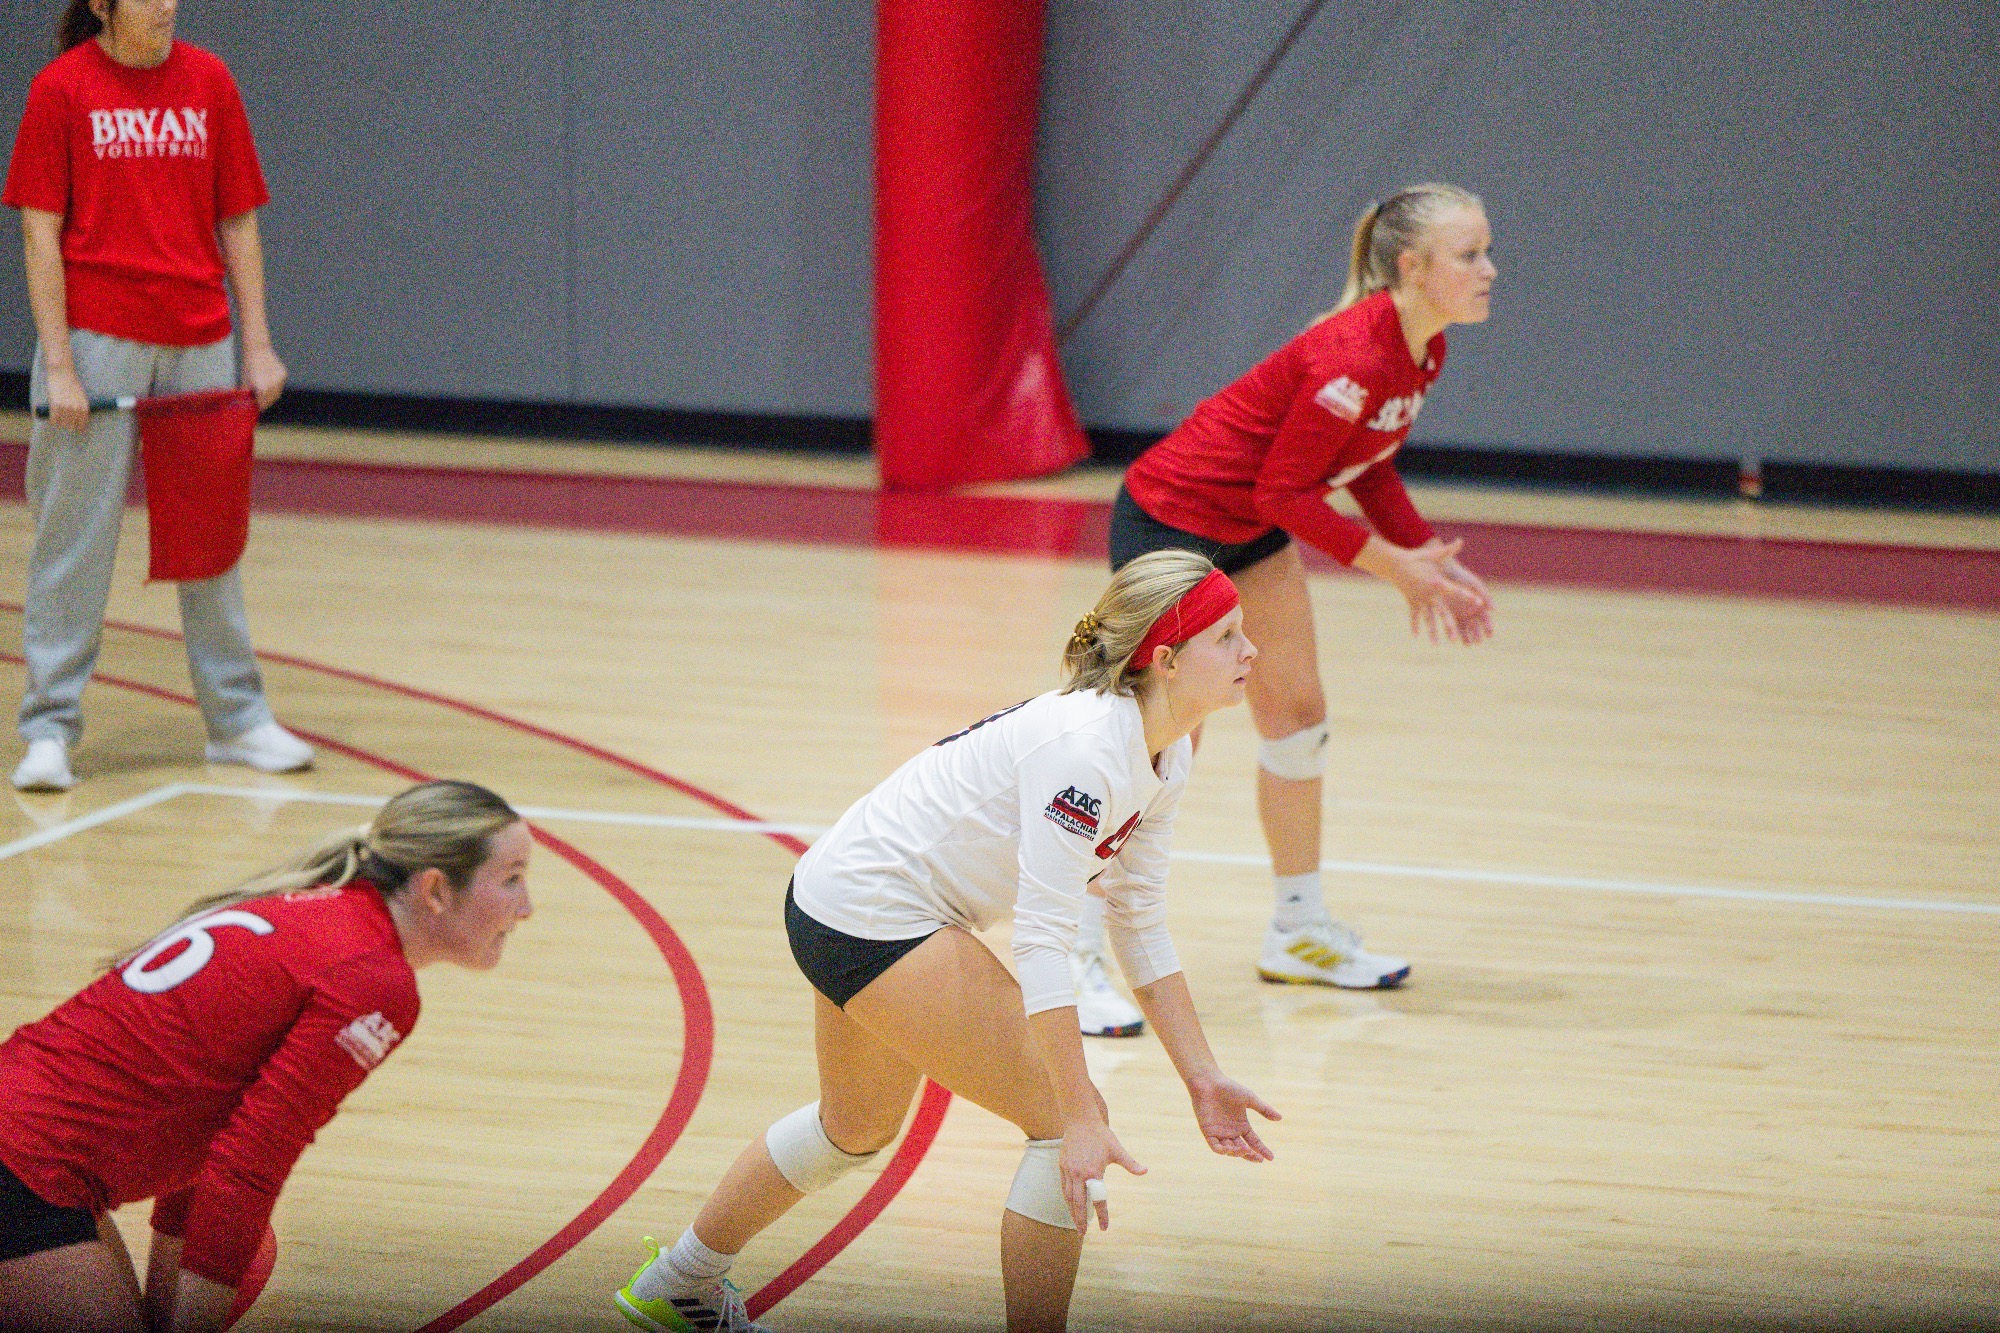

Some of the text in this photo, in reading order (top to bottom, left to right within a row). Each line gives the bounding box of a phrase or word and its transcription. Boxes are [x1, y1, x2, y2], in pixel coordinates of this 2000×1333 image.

[88, 106, 208, 145] BRYAN
[1061, 785, 1102, 816] AAC
[1045, 804, 1098, 835] APPALACHIAN
[114, 906, 276, 995] 6
